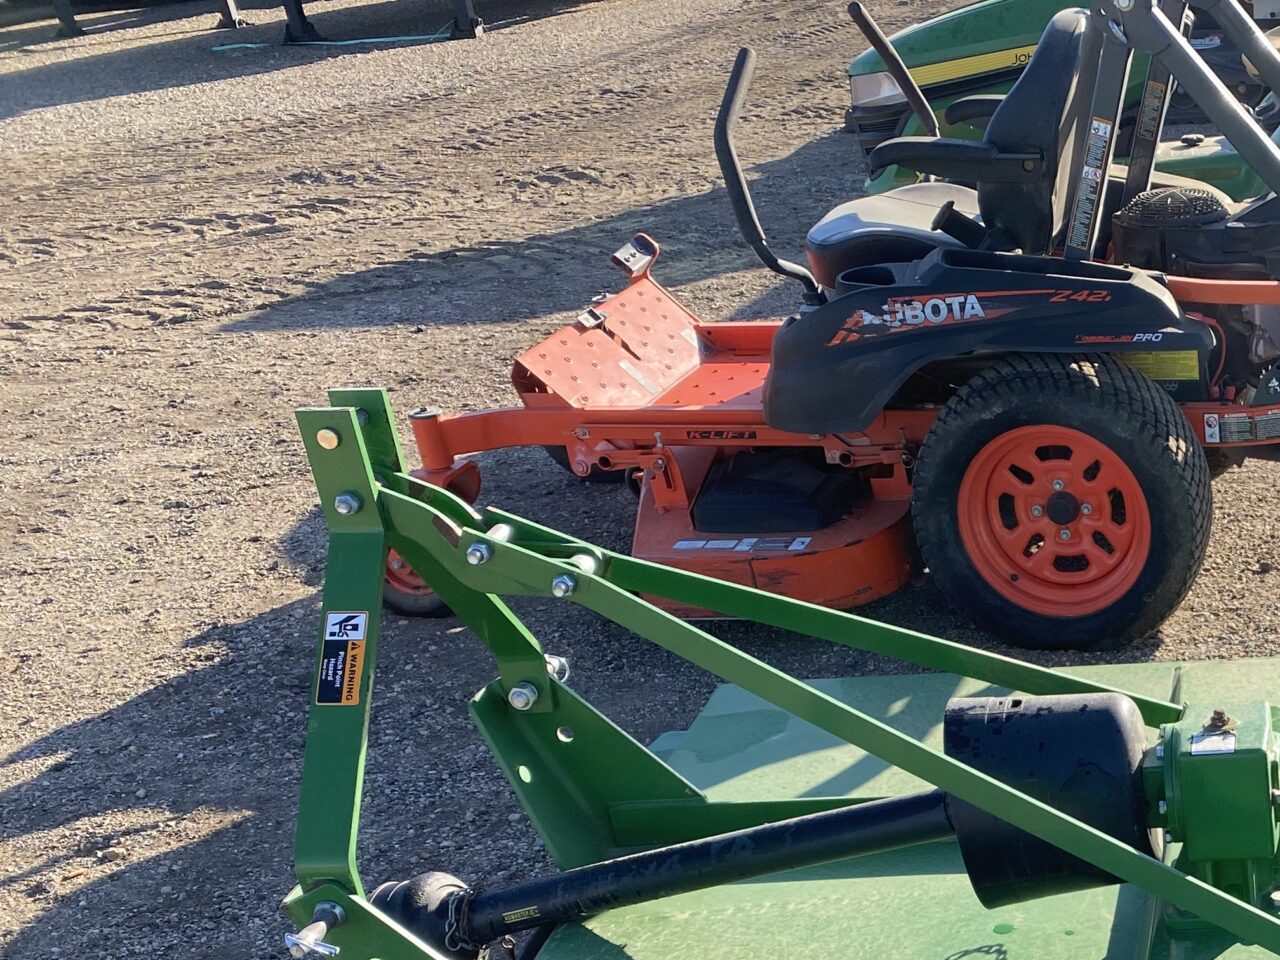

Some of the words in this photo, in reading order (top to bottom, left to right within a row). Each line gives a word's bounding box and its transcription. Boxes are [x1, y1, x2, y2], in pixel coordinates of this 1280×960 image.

[1133, 333, 1163, 342] PRO
[688, 431, 756, 439] K-LIFT
[337, 651, 345, 669] Pinch
[327, 658, 336, 681] Hazard
[335, 669, 343, 688] Point
[346, 654, 358, 701] WARNING
